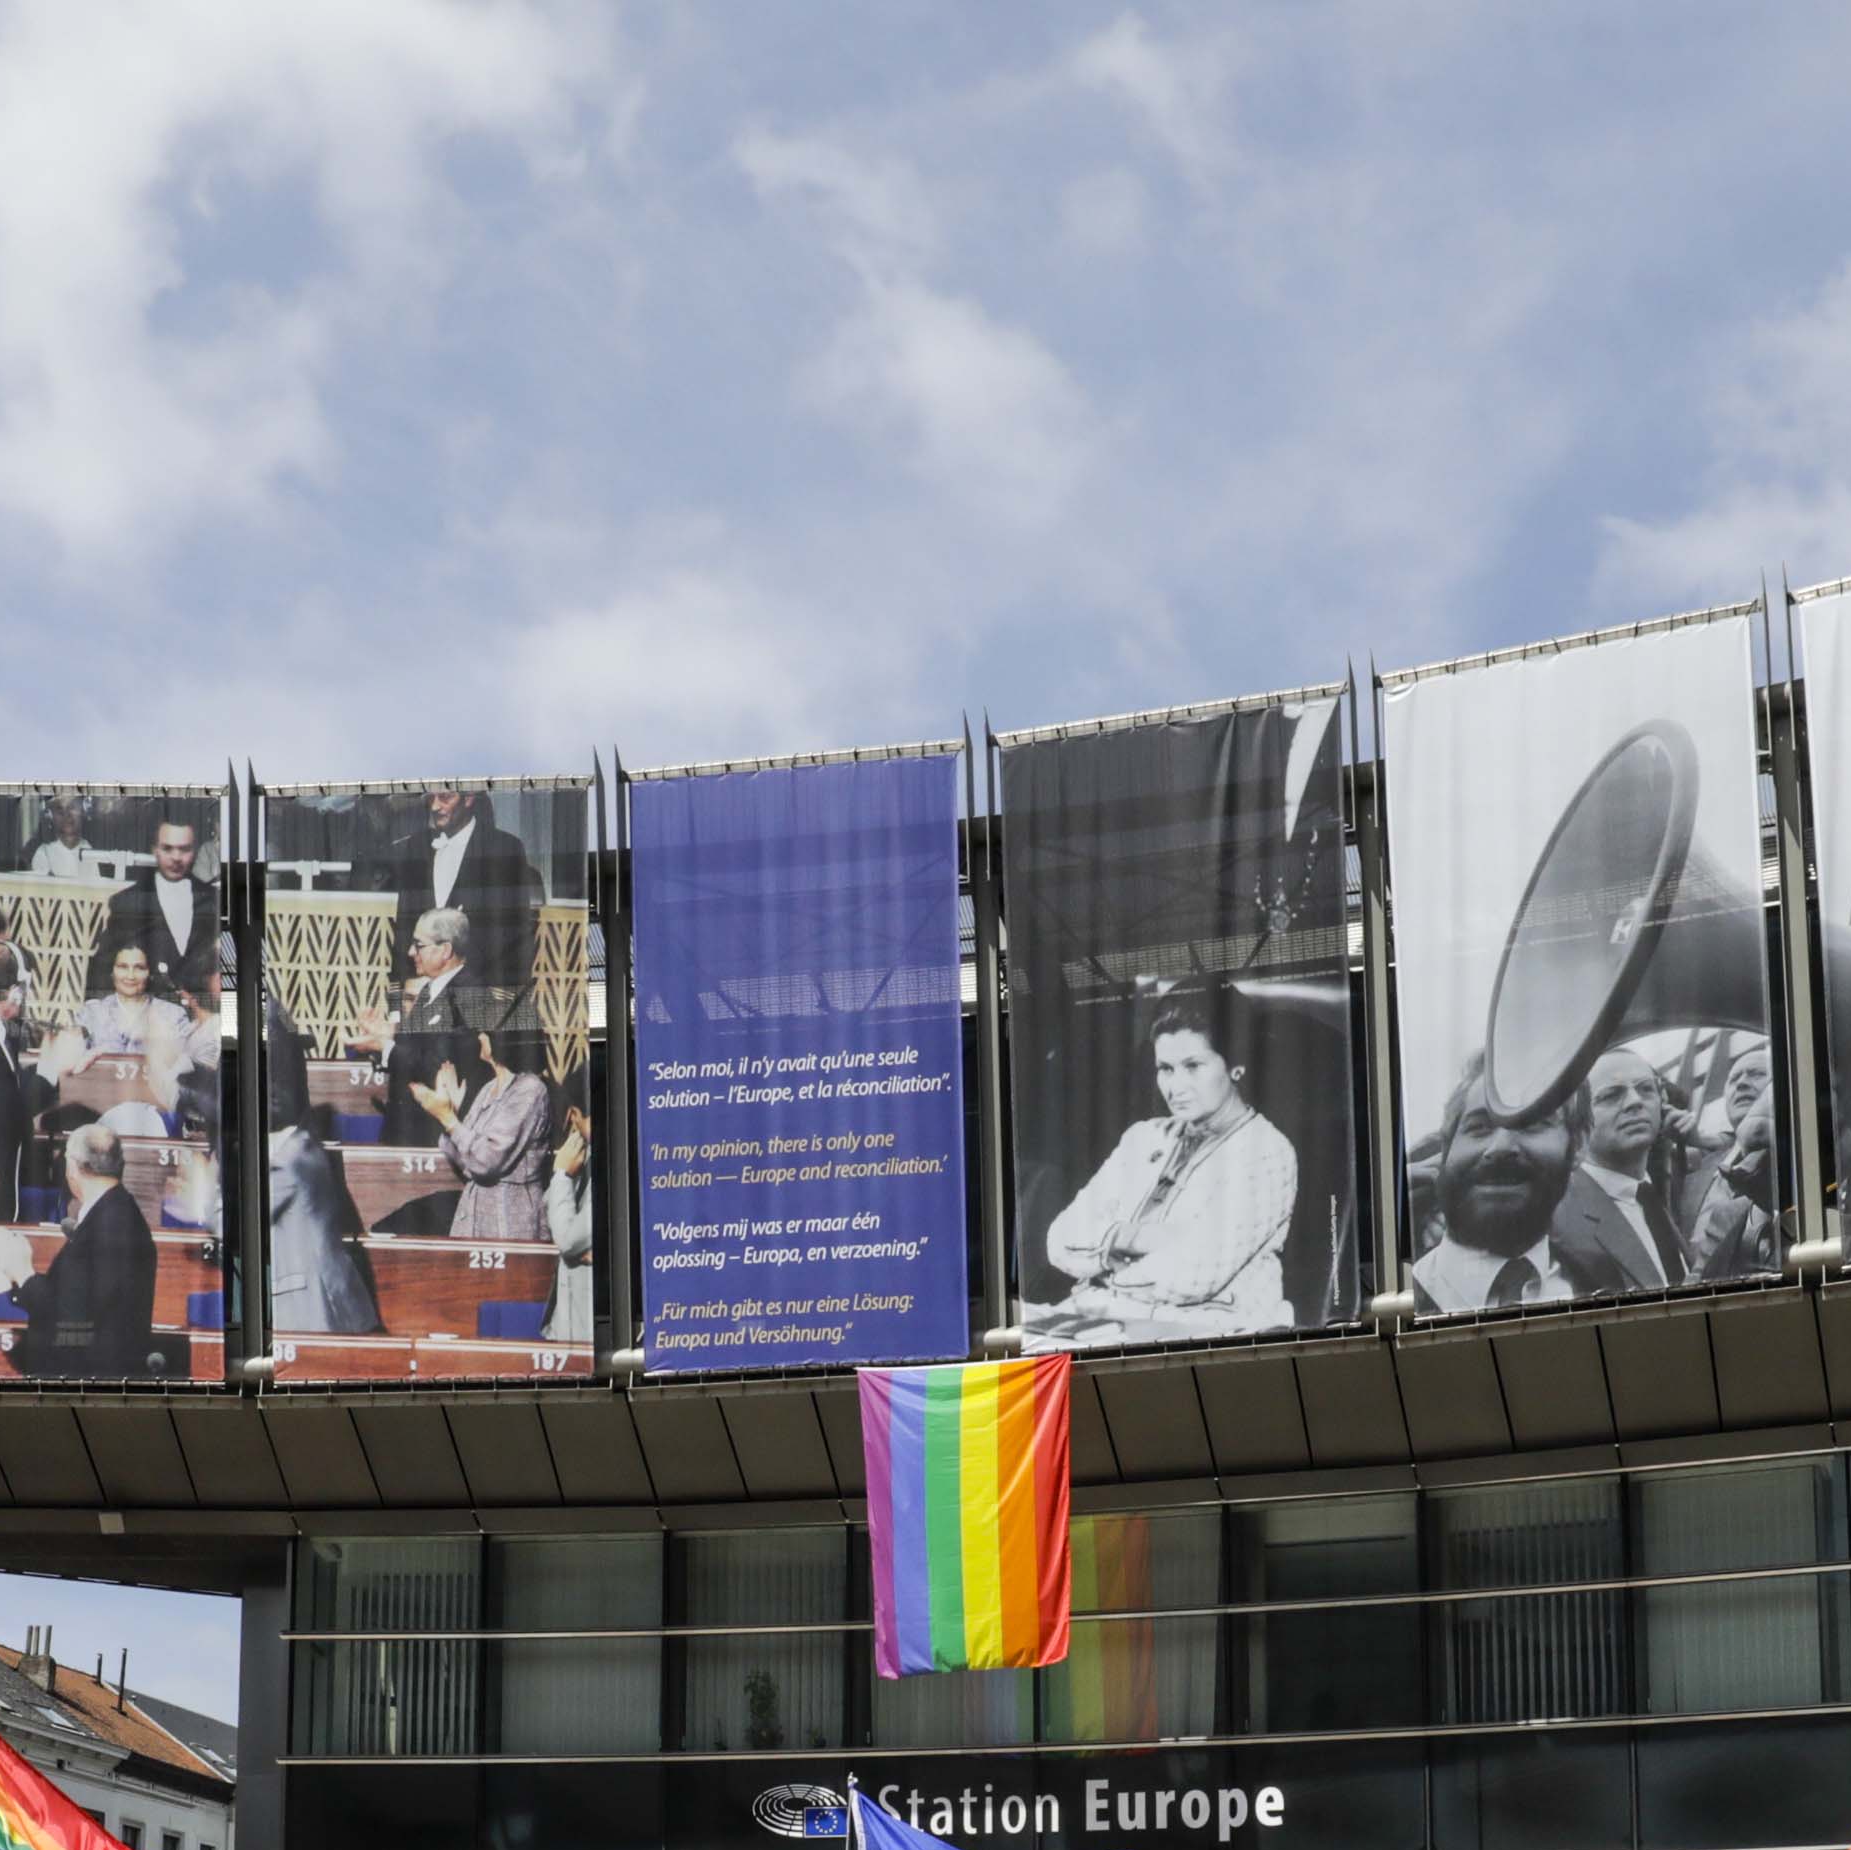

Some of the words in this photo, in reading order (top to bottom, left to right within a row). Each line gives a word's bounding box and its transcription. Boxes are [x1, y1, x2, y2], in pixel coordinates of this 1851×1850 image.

[701, 1058, 734, 1078] moi,
[739, 1056, 748, 1074] il
[778, 1053, 817, 1072] avait
[878, 1045, 918, 1066] seule
[648, 1089, 709, 1109] solution
[799, 1083, 815, 1099] et
[817, 1080, 832, 1098] la
[672, 1145, 697, 1163] my
[700, 1139, 763, 1161] opinion,
[768, 1136, 808, 1154] there
[811, 1134, 822, 1151] is
[827, 1131, 861, 1154] only
[864, 1133, 894, 1148] one
[402, 1157, 436, 1173] 314
[651, 1170, 712, 1189] solution
[741, 1166, 796, 1186] Europe
[800, 1160, 832, 1180] and
[723, 1219, 749, 1240] mij
[752, 1221, 782, 1236] was
[786, 1220, 802, 1233] er
[805, 1216, 849, 1232] maar
[852, 1212, 880, 1230] één
[469, 1251, 505, 1269] 252
[653, 1249, 725, 1272] oplossing
[744, 1246, 803, 1266] Europa,
[807, 1247, 826, 1261] en
[690, 1300, 728, 1318] mich
[732, 1298, 762, 1321] gibt
[766, 1301, 781, 1315] es
[786, 1300, 814, 1314] nur
[816, 1296, 850, 1312] eine
[853, 1293, 914, 1313] Lösung:
[656, 1331, 710, 1351] Europa
[714, 1326, 746, 1345] und
[877, 1783, 1060, 1836] Station
[1085, 1779, 1286, 1842] Europe
